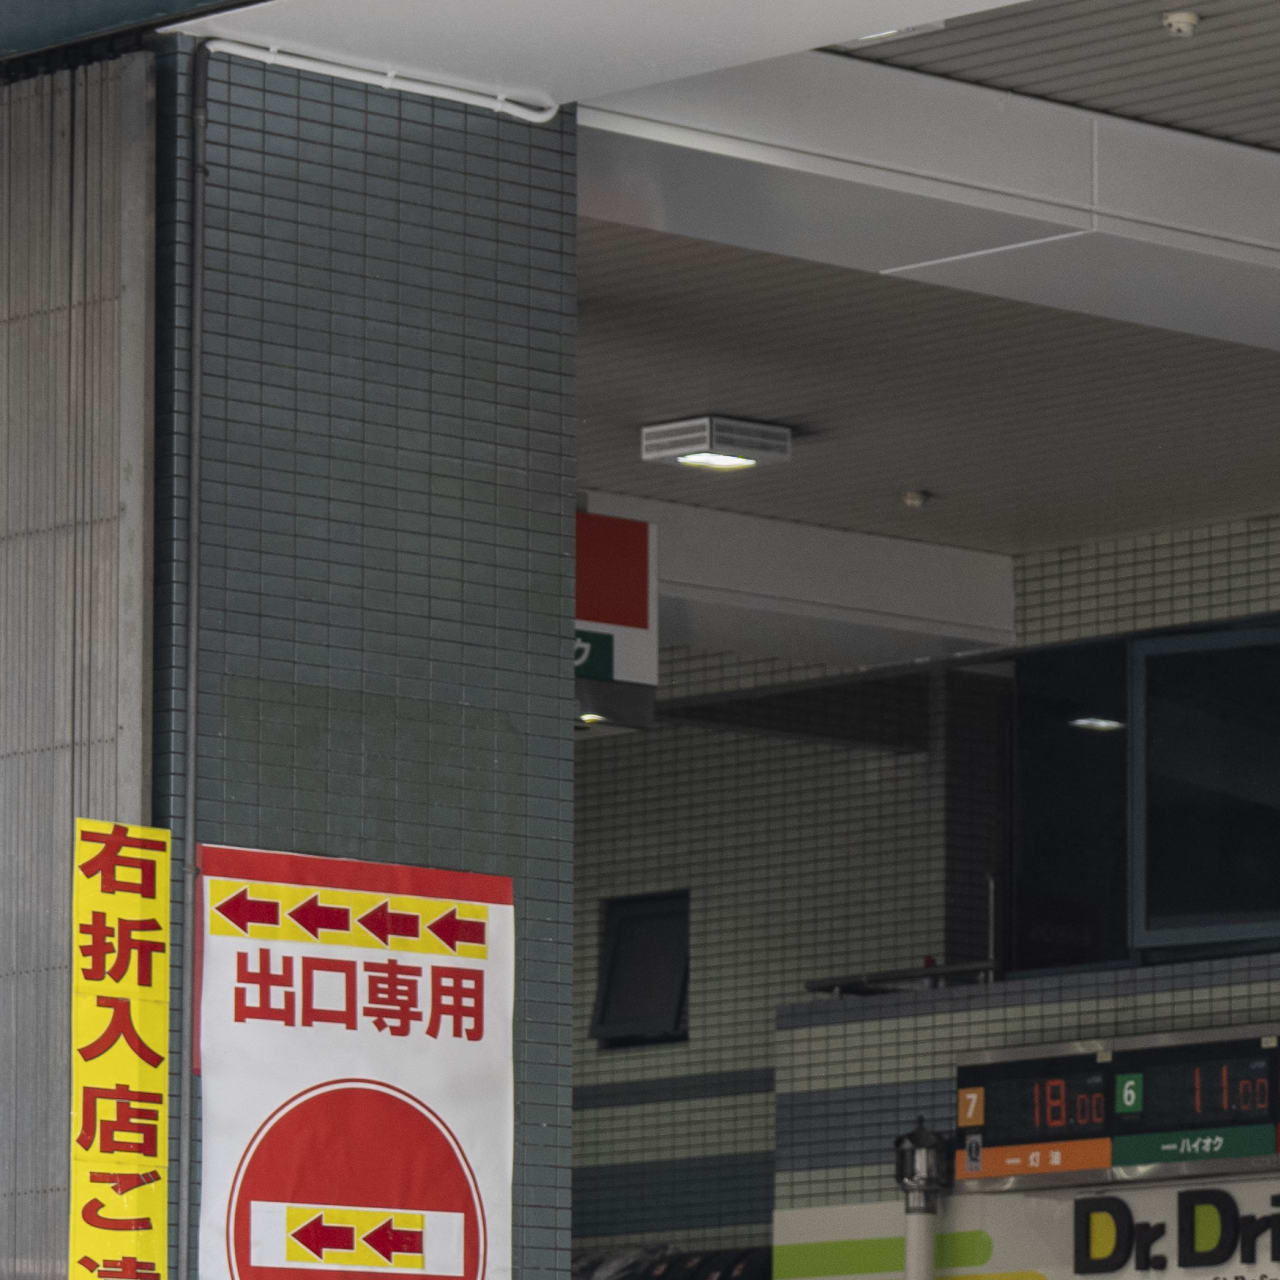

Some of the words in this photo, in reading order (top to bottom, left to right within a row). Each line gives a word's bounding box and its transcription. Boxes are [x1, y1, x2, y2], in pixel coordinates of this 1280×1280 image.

[233, 948, 486, 1042] 出口専用
[965, 1093, 979, 1118] 7
[1122, 1079, 1137, 1107] 6
[1179, 1136, 1224, 1153] ハイオク
[1073, 1196, 1168, 1274] Dr.
